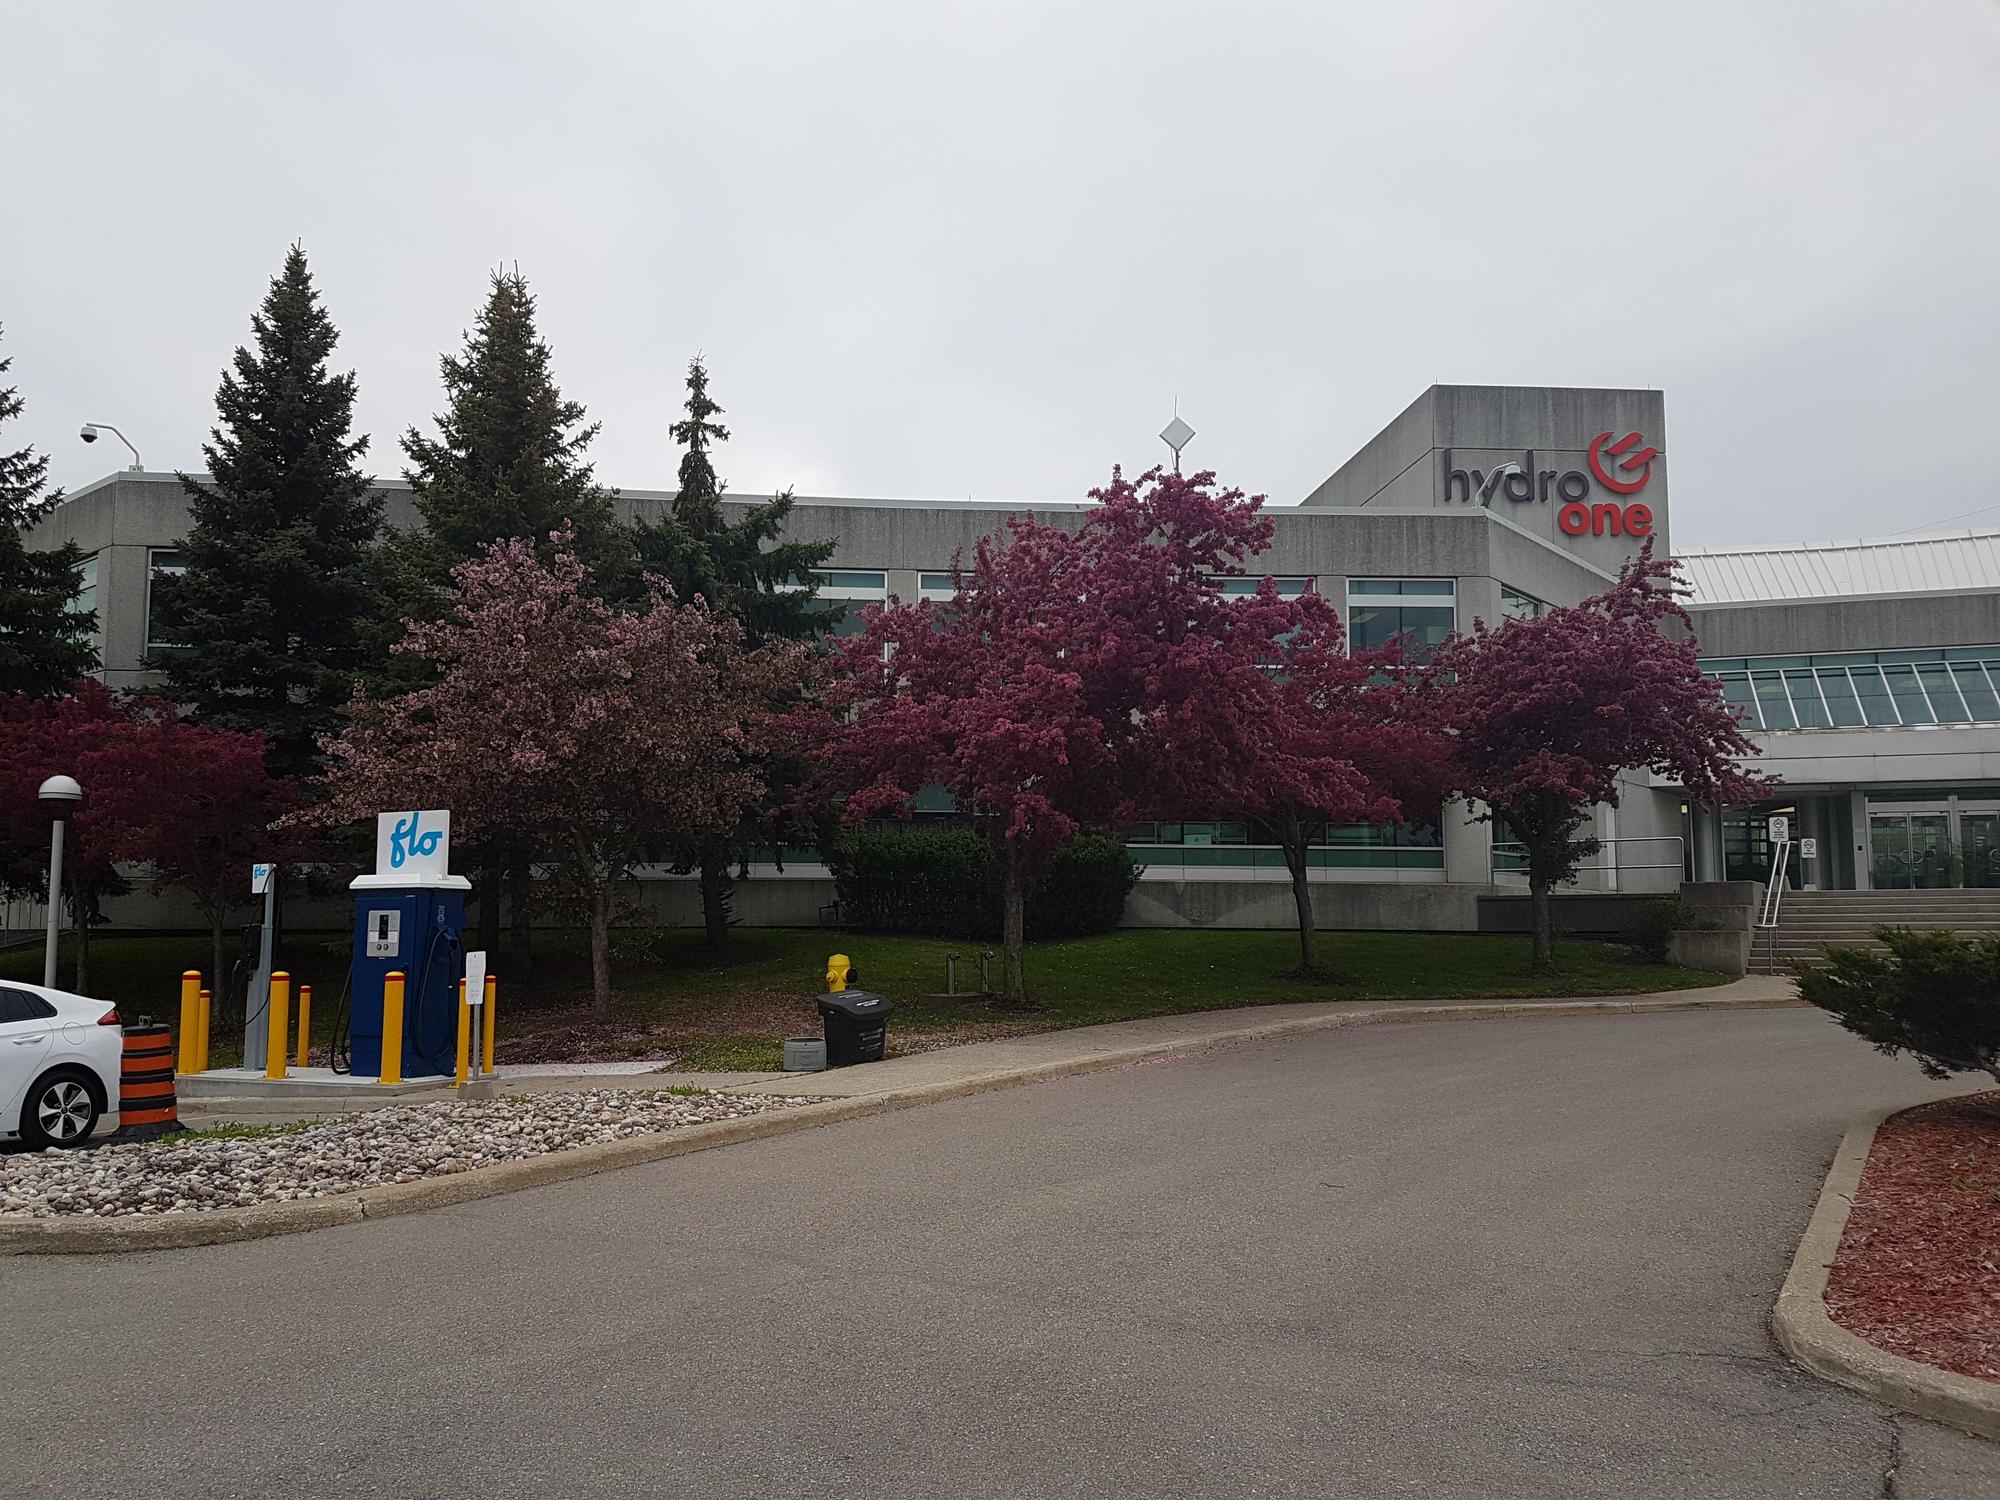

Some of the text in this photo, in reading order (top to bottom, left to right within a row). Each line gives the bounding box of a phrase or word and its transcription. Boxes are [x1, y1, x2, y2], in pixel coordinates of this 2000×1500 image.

[1444, 448, 1590, 508] hydro
[1558, 502, 1653, 537] one
[390, 812, 443, 868] flo
[254, 865, 268, 880] flo
